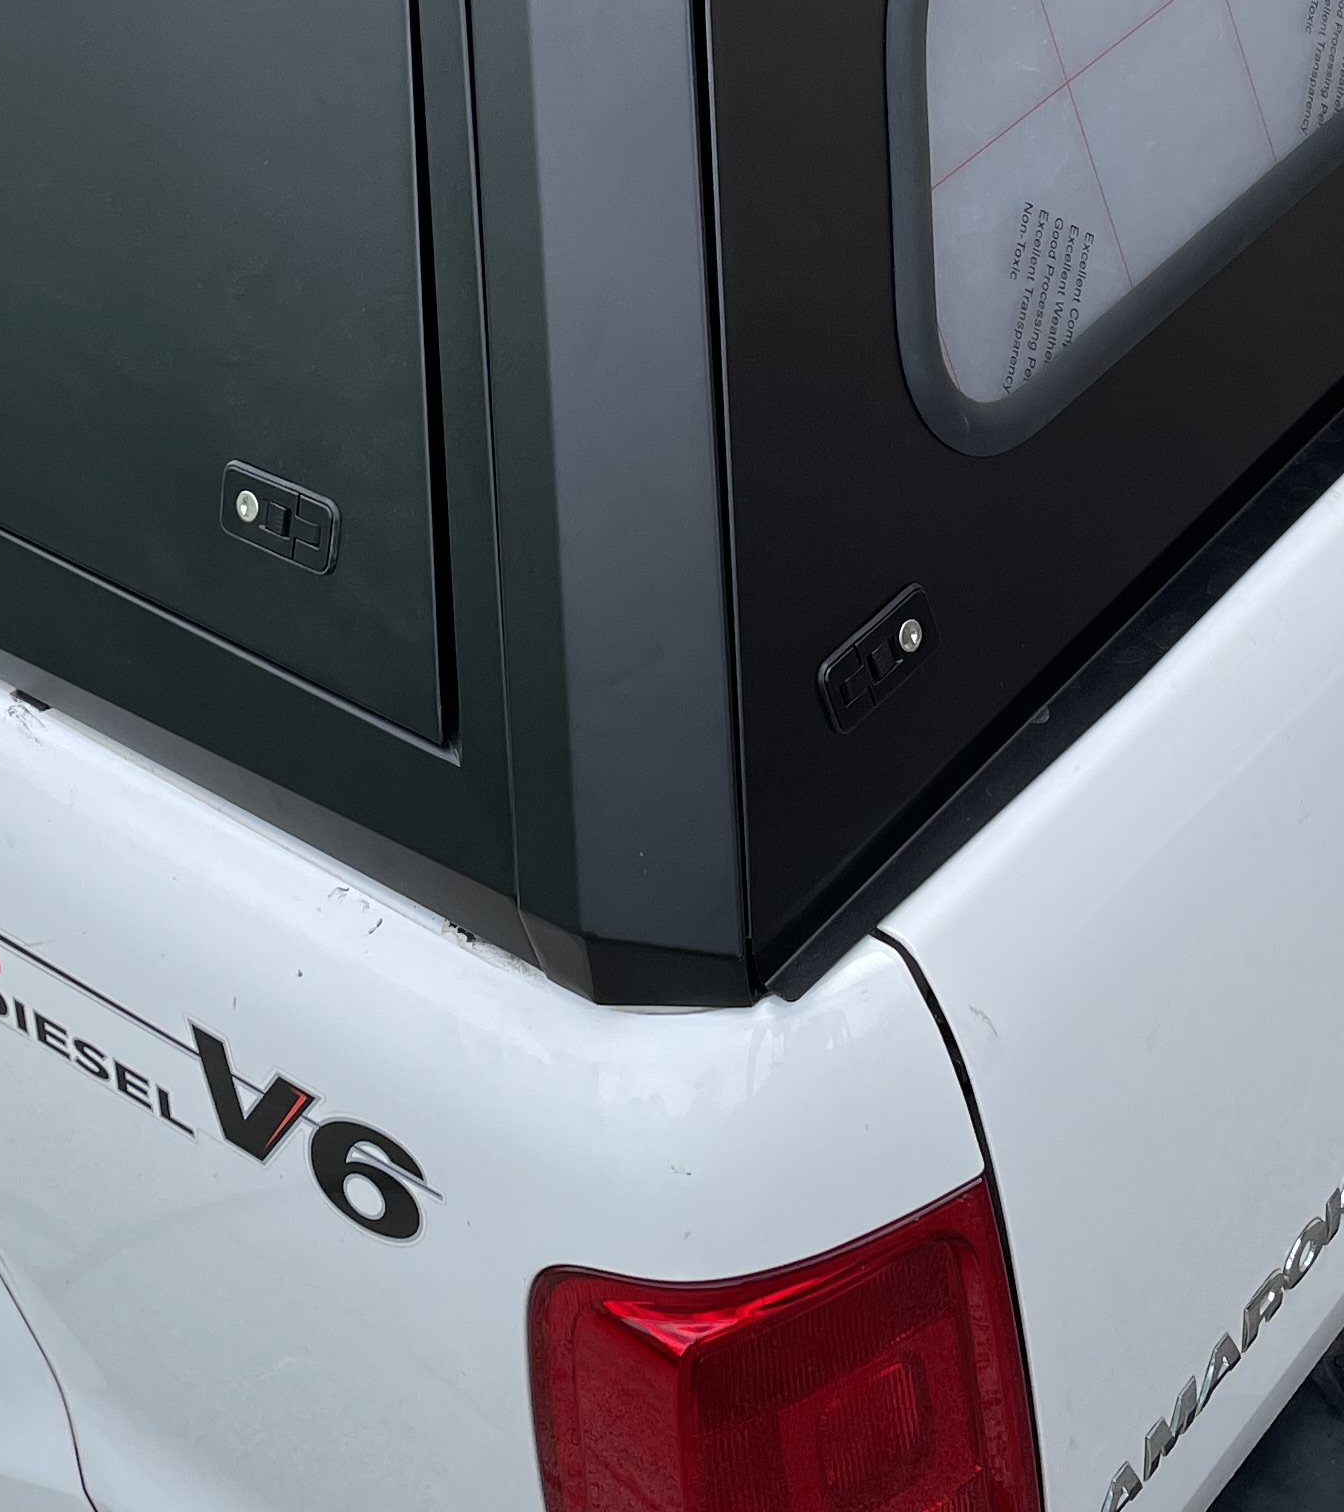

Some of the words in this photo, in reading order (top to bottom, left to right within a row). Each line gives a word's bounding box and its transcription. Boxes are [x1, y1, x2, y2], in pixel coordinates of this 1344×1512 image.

[1300, 41, 1325, 136] Transparency
[1320, 22, 1343, 99] Processing
[1026, 209, 1049, 282] Excellent
[1048, 217, 1064, 260] Good
[1057, 224, 1080, 296] Excellent
[1072, 231, 1095, 303] Excellent
[1002, 288, 1034, 394] Transparency
[1027, 264, 1055, 351] Processing
[191, 1020, 426, 1241] V6
